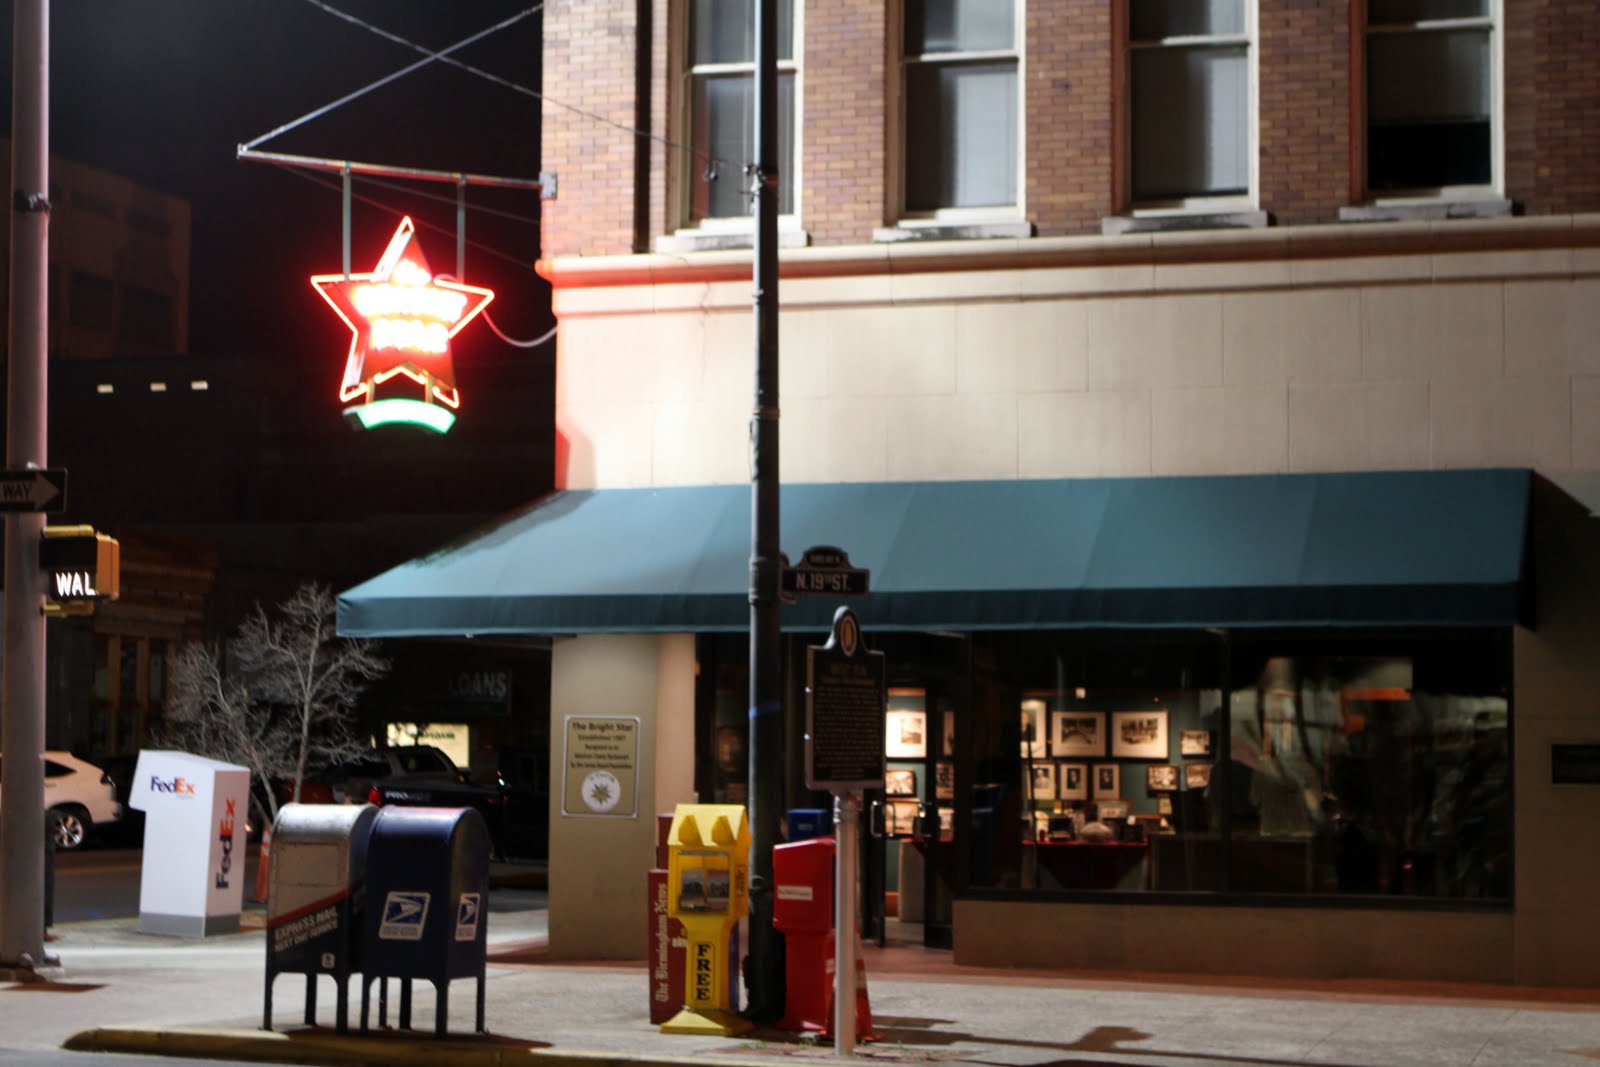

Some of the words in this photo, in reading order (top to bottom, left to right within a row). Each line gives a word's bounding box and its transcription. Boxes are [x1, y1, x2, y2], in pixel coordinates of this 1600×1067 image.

[3, 481, 32, 499] WAY
[56, 571, 97, 597] WAL
[449, 672, 508, 697] LOANS
[589, 722, 614, 733] Bright
[150, 775, 195, 794] FedEx
[215, 797, 236, 890] FedEx
[274, 914, 316, 942] EXPRESS
[655, 914, 670, 980] Birmingham
[697, 943, 711, 1001] FREE
